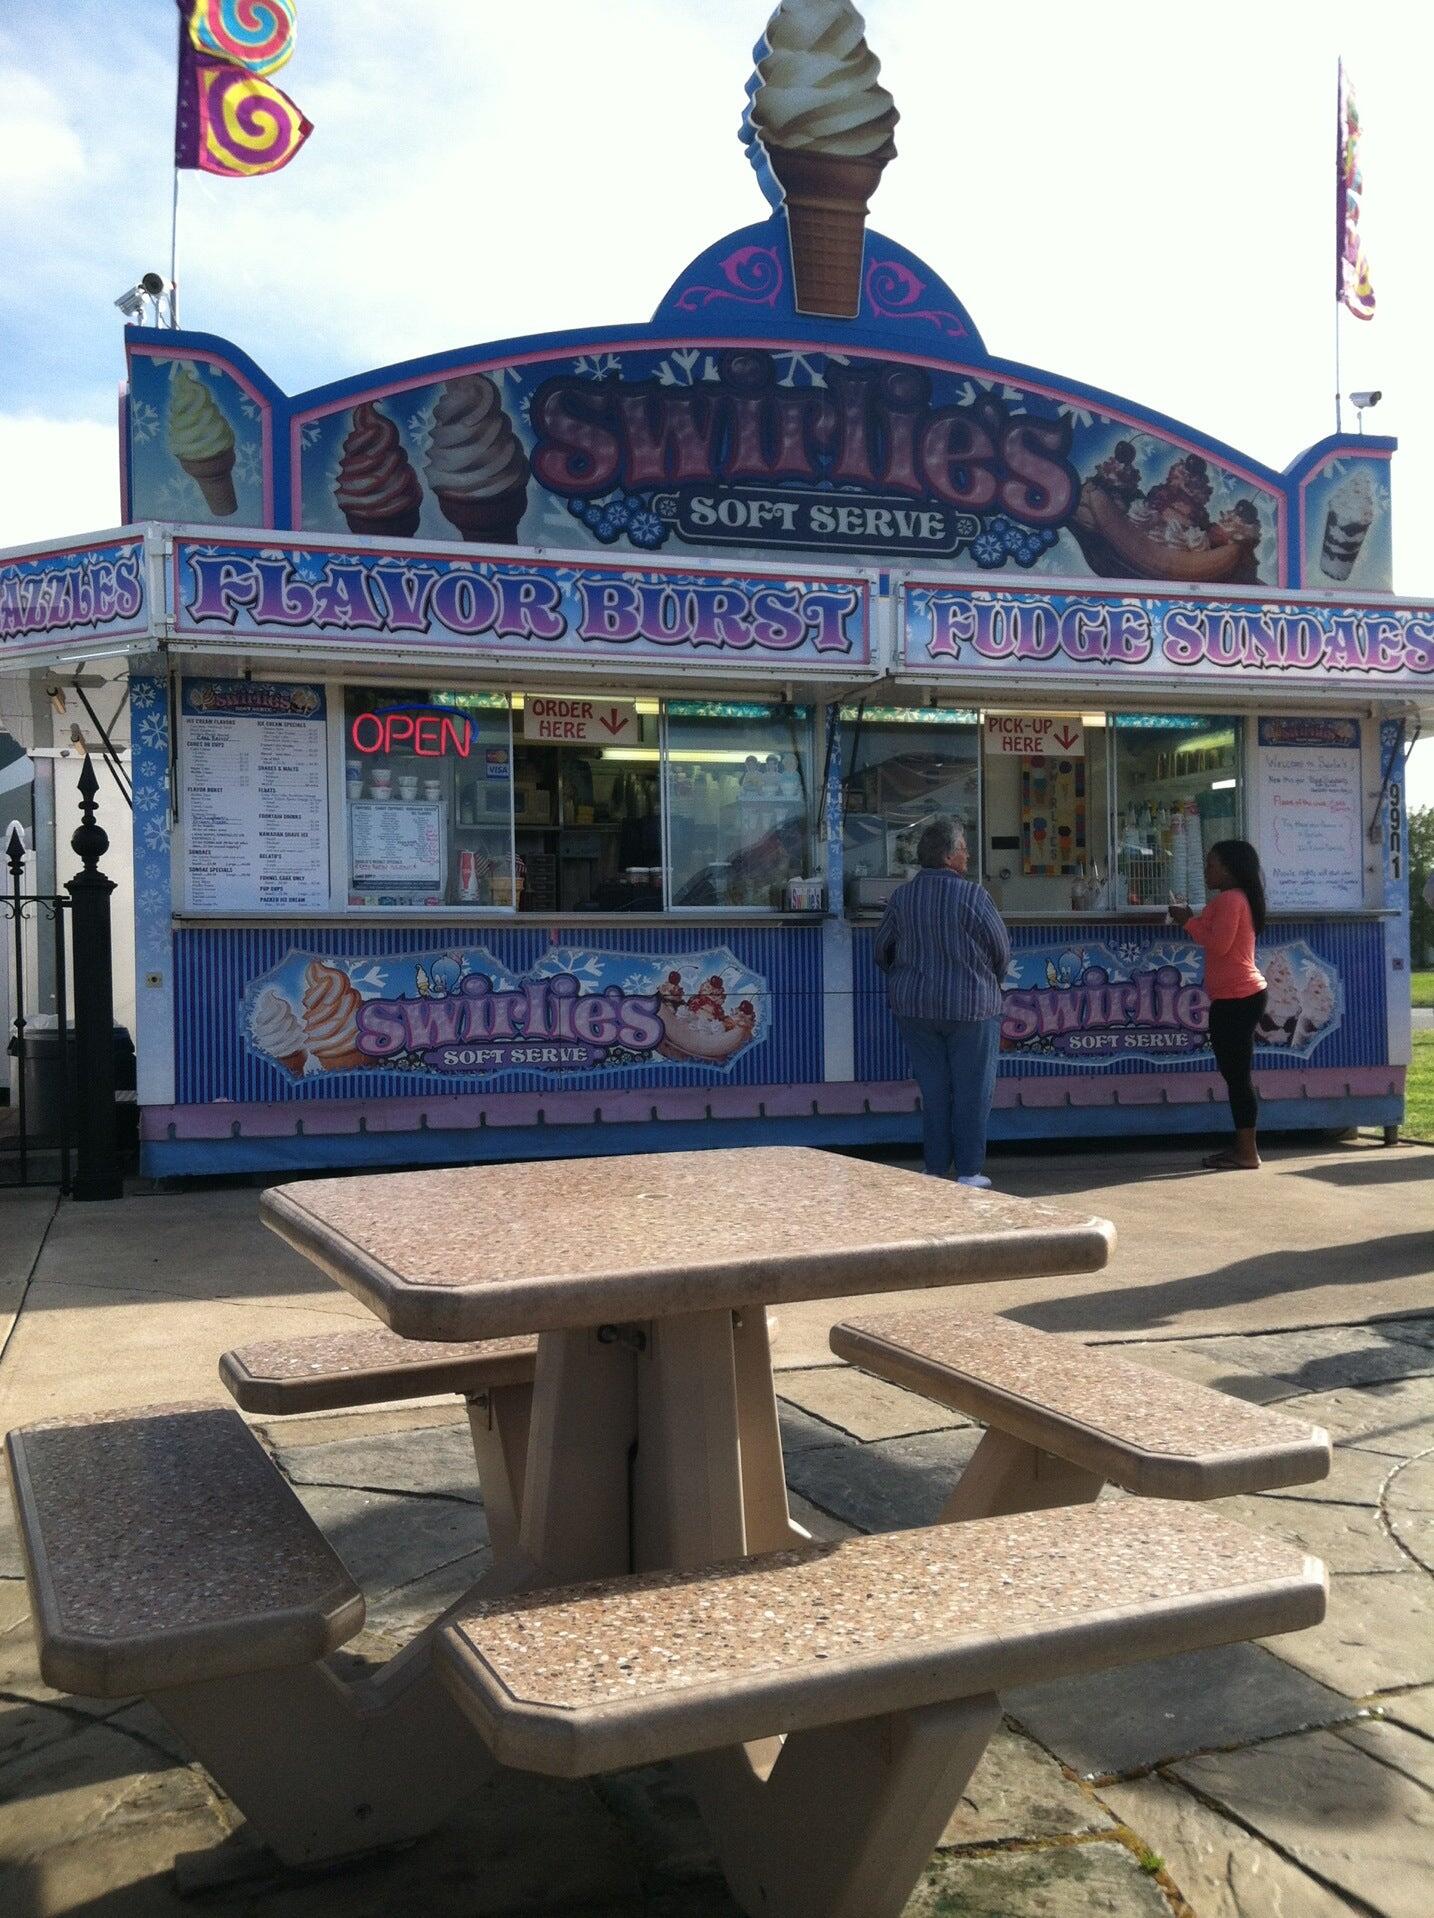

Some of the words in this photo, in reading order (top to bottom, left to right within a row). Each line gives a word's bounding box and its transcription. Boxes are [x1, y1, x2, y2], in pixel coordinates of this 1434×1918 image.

[690, 497, 799, 530] SOFT
[810, 505, 946, 540] SERVE
[187, 553, 565, 639] FLAVOR
[576, 574, 858, 654] BURST
[926, 596, 1153, 665] FUDGE
[1163, 606, 1434, 674] SUNDAES
[533, 700, 593, 719] ORDER
[353, 713, 471, 758] OPEN
[539, 720, 586, 738] HERE
[989, 718, 1052, 734] PICK-UP
[1003, 736, 1044, 752] HERE
[1070, 1034, 1121, 1050] SOFT
[1125, 1032, 1188, 1048] SERVE
[444, 1048, 503, 1066] SOFT
[511, 1047, 588, 1063] SERVE
